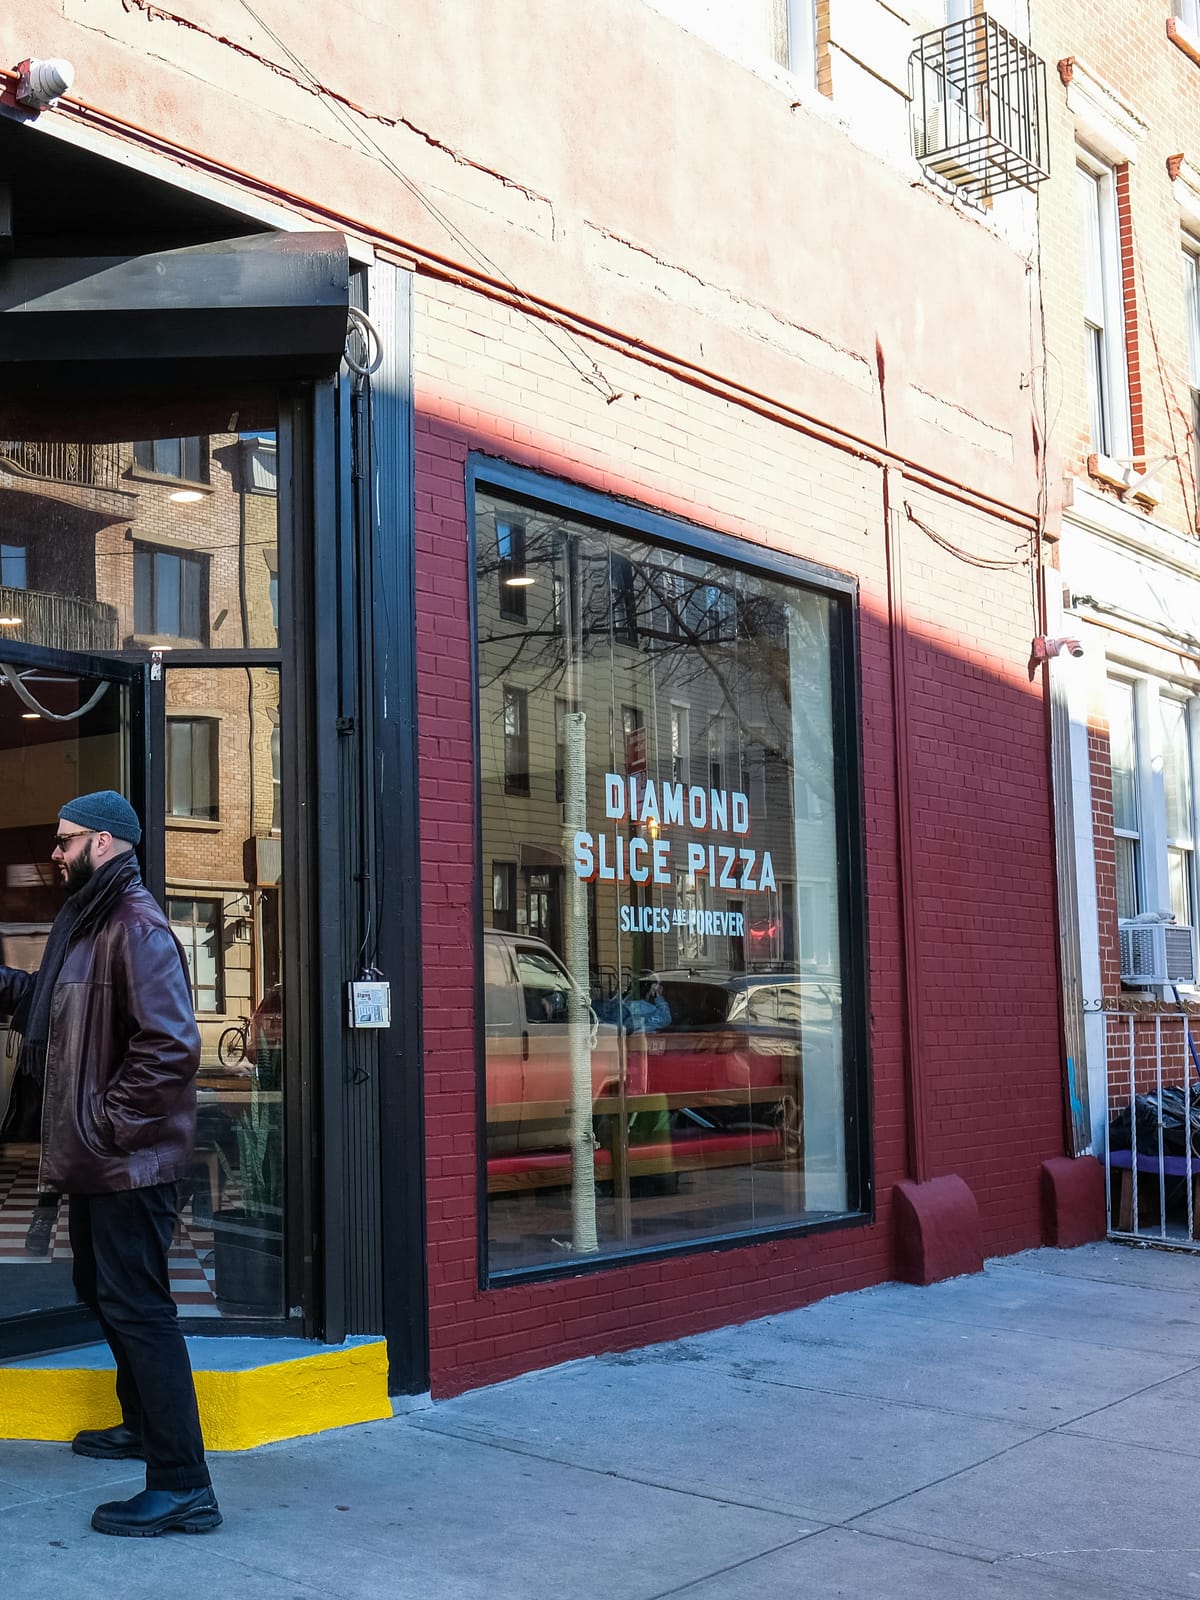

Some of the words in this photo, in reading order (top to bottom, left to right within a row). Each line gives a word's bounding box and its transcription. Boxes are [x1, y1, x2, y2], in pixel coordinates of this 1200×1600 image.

[605, 773, 750, 836] DIAMOND
[573, 831, 672, 885] SLICE
[687, 842, 777, 893] PIZZA
[620, 905, 670, 933] SLICES
[672, 908, 687, 921] ARE
[688, 909, 745, 936] FOREVER
